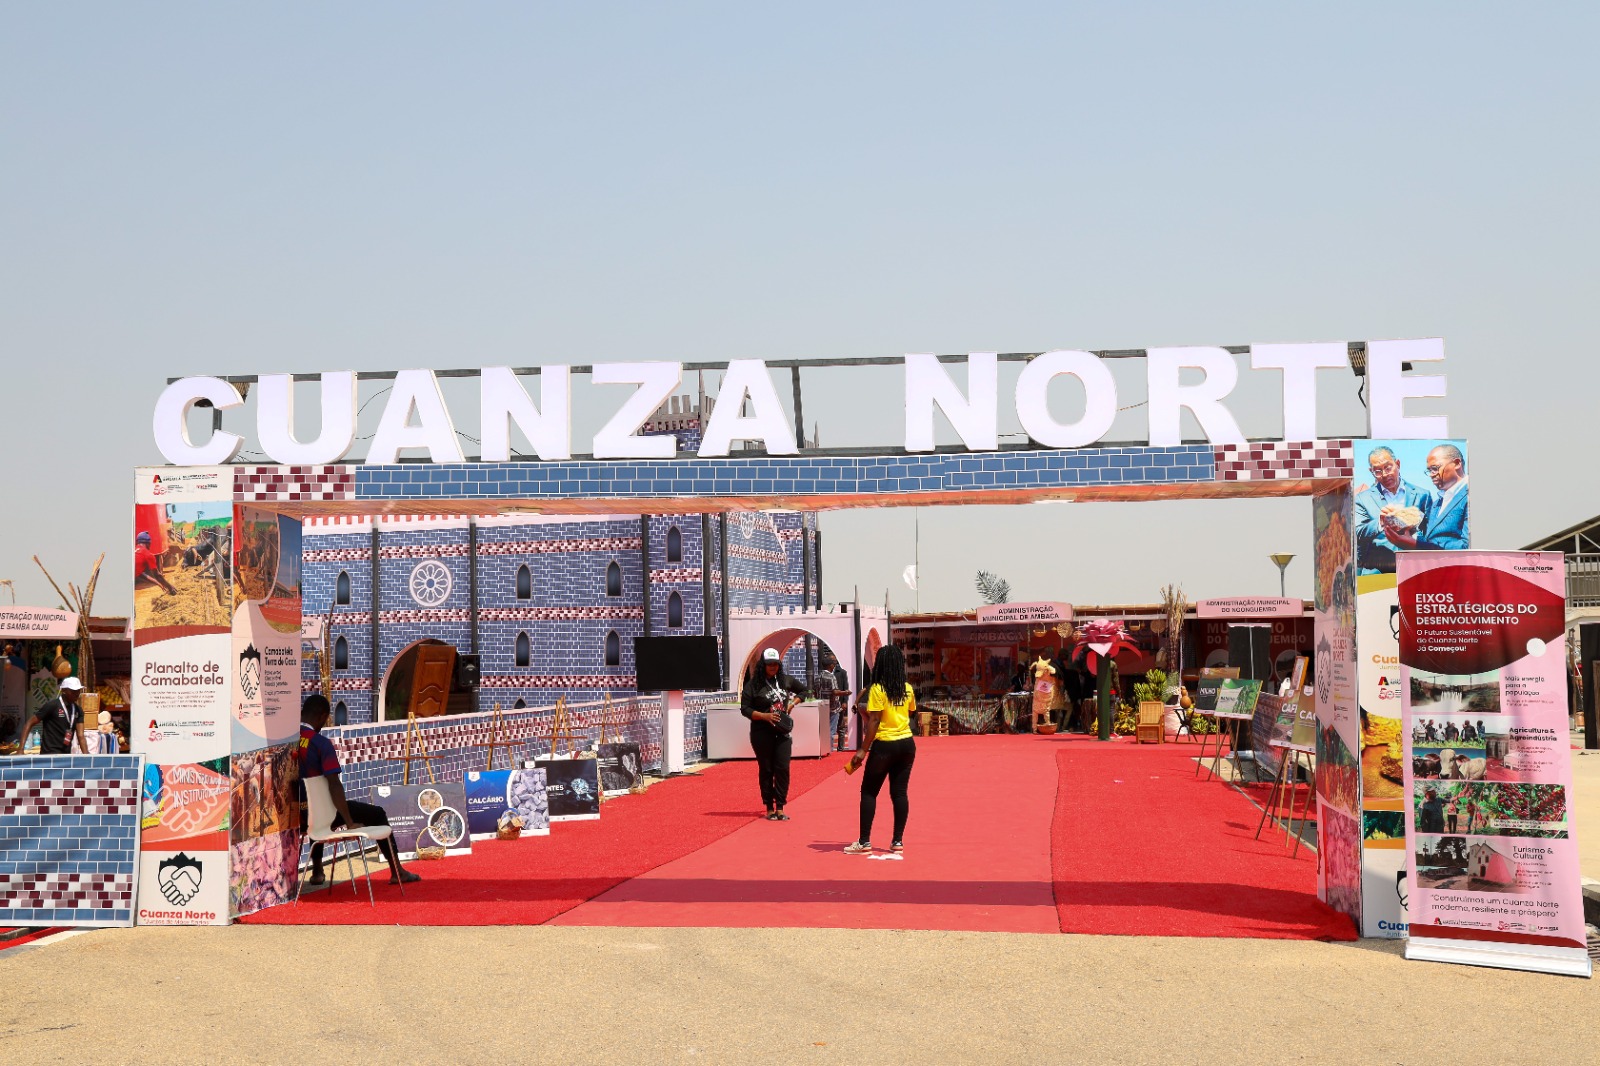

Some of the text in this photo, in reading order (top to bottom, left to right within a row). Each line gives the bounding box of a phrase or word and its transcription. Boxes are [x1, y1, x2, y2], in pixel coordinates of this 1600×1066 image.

[153, 337, 1449, 466] CUANZA NORTE
[1415, 593, 1454, 603] EIXOS
[998, 605, 1054, 614] ADMINISTRAÇÃO
[1415, 601, 1538, 614] ESTRATÉGICOS DO
[1416, 616, 1519, 625] DESENVOLVIMENTO
[1428, 645, 1467, 653] Começou!
[1372, 654, 1399, 664] Cua
[145, 661, 199, 674] Planalto
[203, 660, 219, 673] de
[141, 673, 224, 686] Camabatela
[468, 796, 504, 805] CALCÁRIO
[1513, 846, 1546, 854] Turismo
[140, 909, 216, 919] Cuanza Norte
[1472, 906, 1509, 914] resiliente
